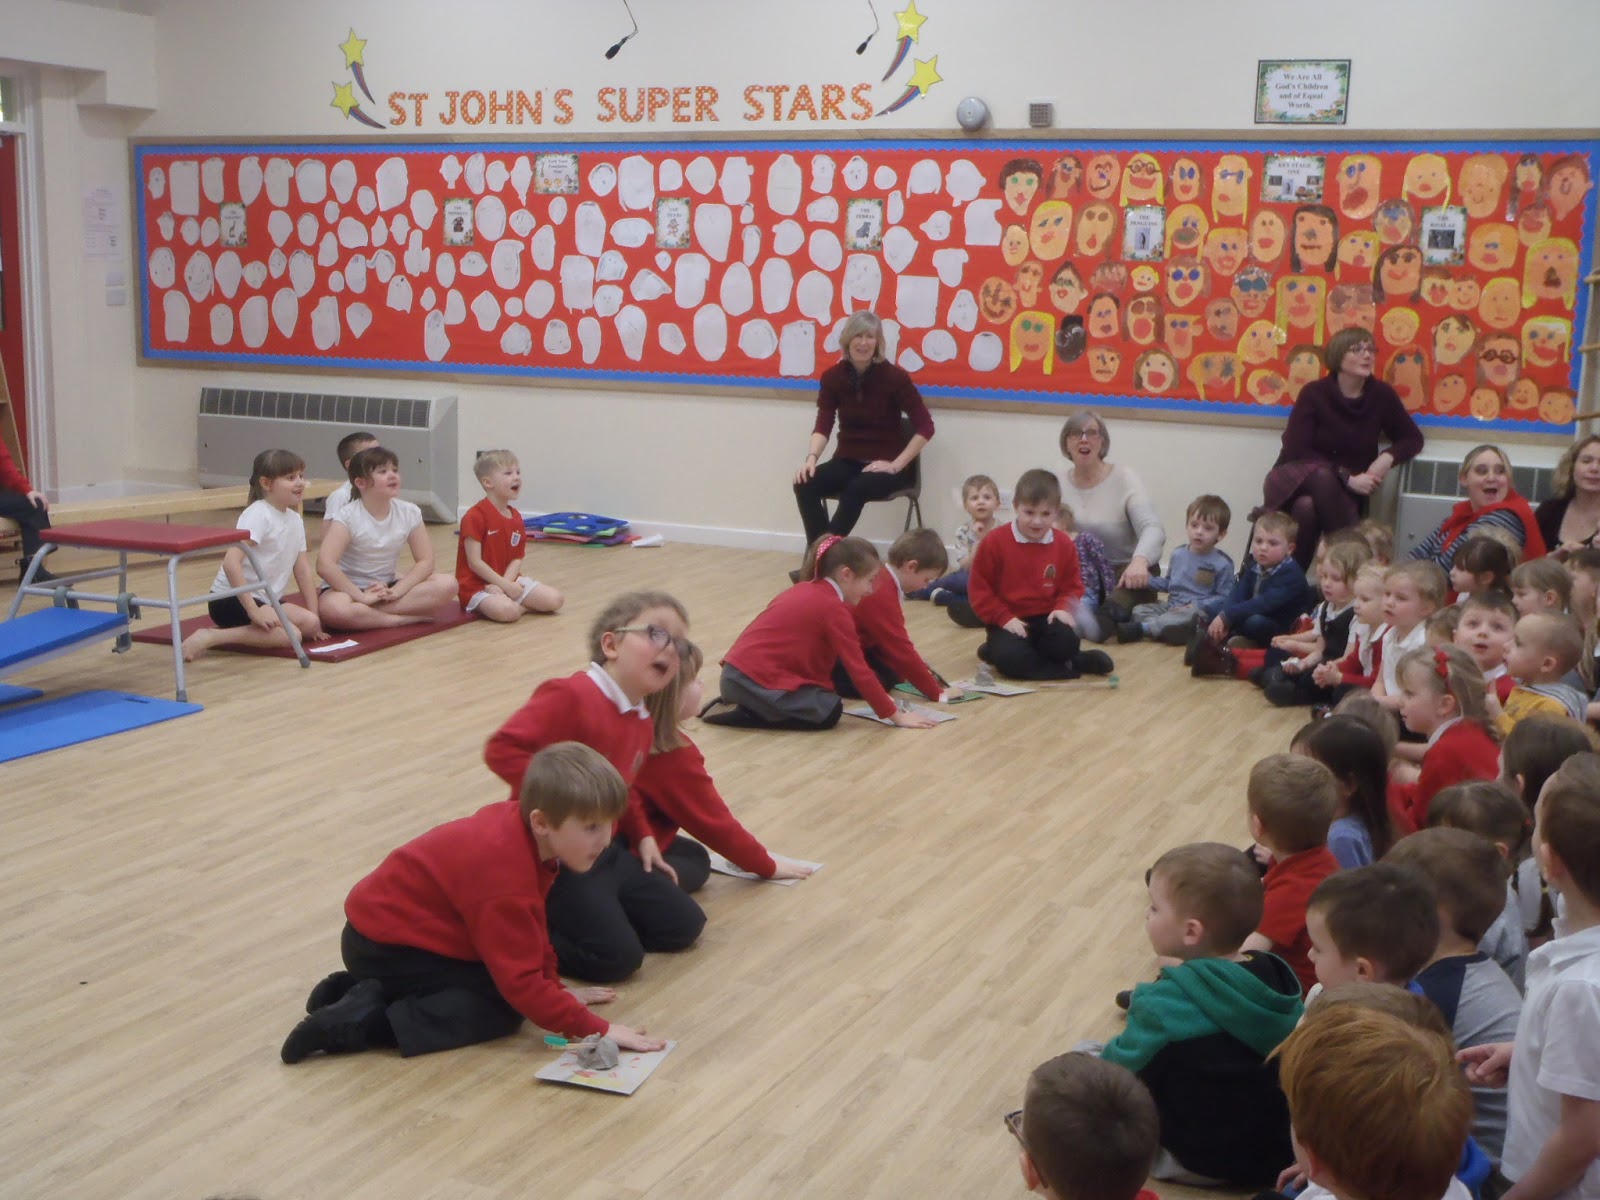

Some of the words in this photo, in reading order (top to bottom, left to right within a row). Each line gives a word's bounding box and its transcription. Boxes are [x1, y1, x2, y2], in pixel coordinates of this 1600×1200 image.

[387, 91, 429, 126] ST
[438, 88, 575, 125] JOHN'S
[596, 86, 719, 123] SUPER
[743, 83, 874, 122] STARS
[1302, 92, 1323, 100] Equal
